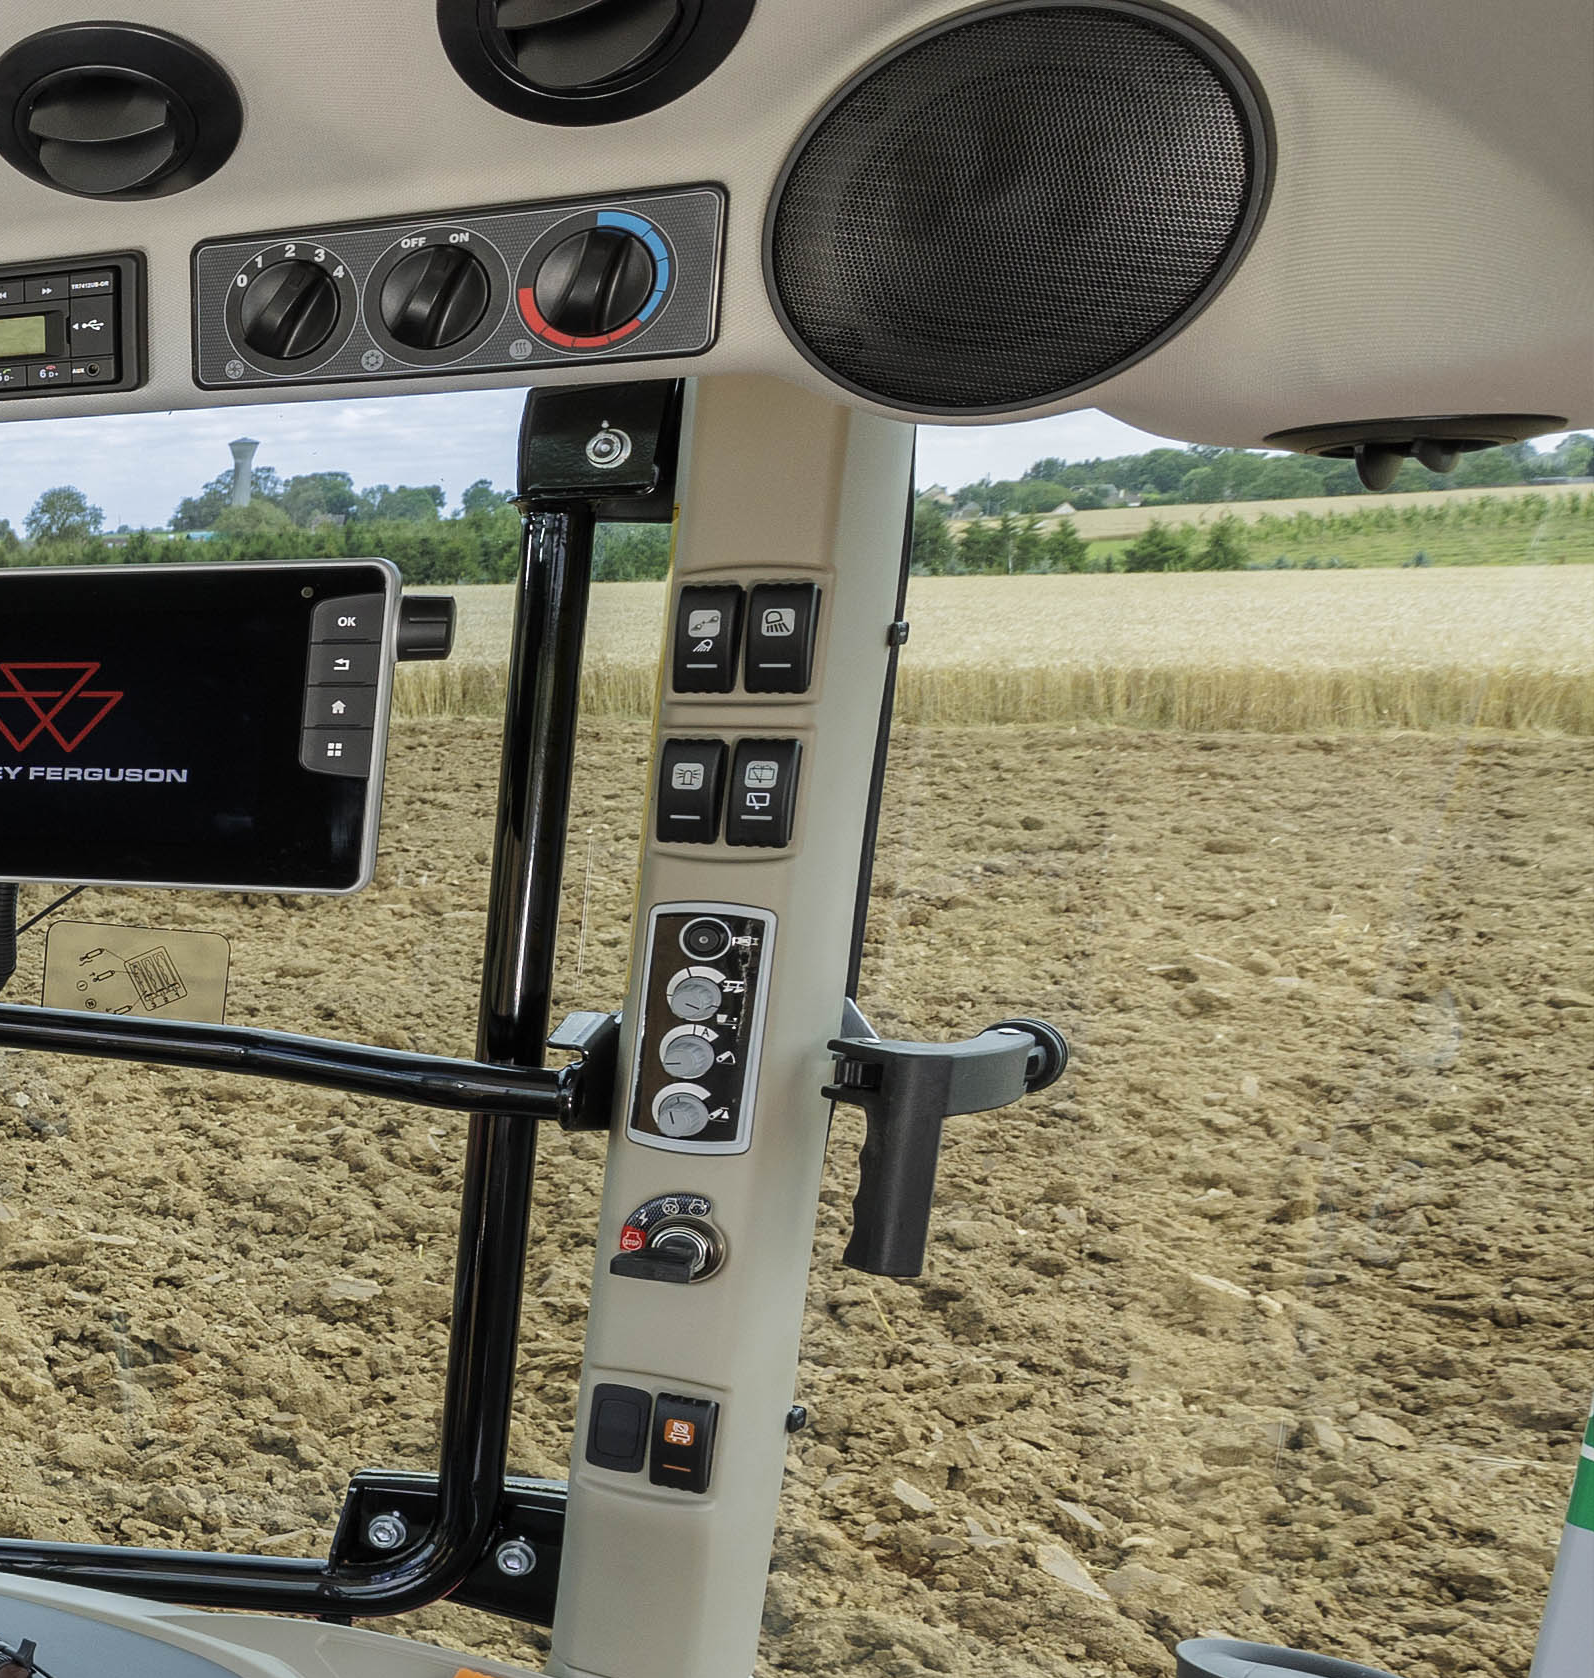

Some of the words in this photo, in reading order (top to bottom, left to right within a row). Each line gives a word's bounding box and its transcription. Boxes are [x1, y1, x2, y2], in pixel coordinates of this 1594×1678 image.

[400, 236, 427, 249] OFF
[448, 231, 470, 244] ON
[236, 274, 248, 288] 0
[254, 255, 263, 268] 1
[284, 243, 296, 258] 2
[314, 248, 326, 263] 3
[332, 264, 345, 279] 4
[39, 369, 47, 378] 6
[337, 615, 357, 627] OK
[28, 766, 188, 783] FERGUSON
[701, 1027, 710, 1037] A
